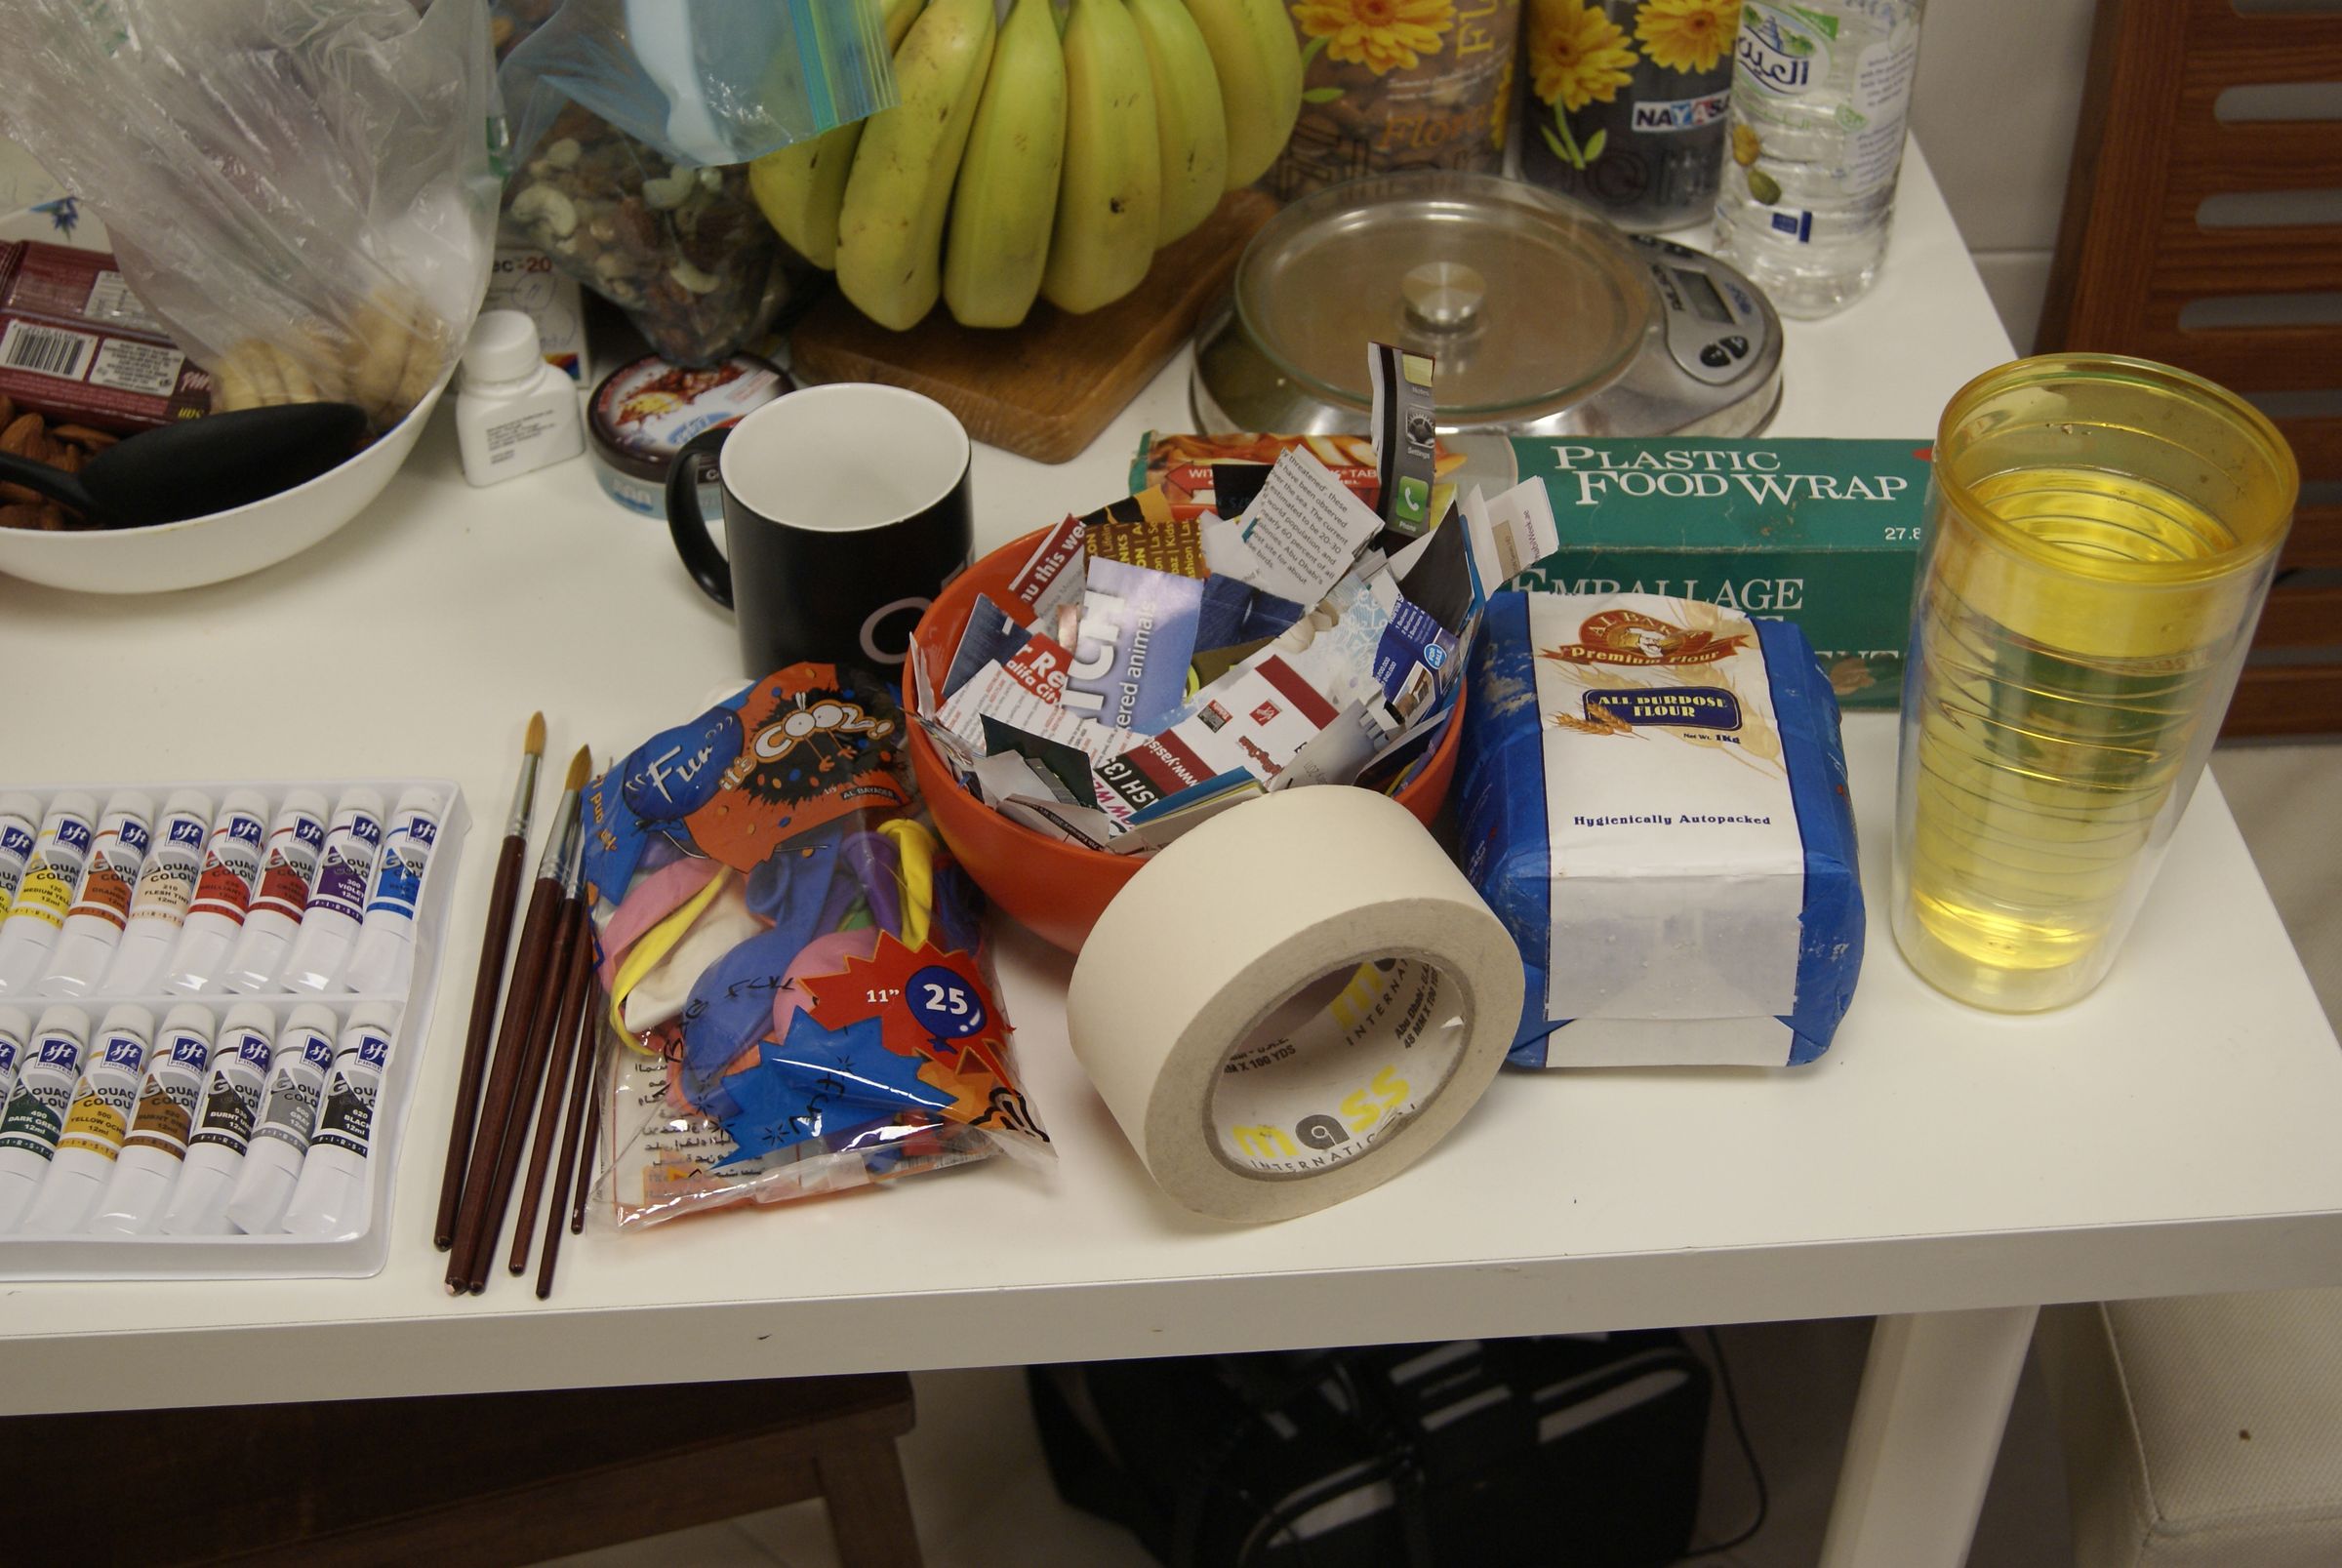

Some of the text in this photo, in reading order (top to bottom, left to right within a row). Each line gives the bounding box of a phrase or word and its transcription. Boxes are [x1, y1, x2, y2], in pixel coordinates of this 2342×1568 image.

[1407, 447, 1431, 460] Settings
[1550, 446, 1781, 471] PLASTIC
[1283, 466, 1347, 527] have been observed
[1572, 470, 1909, 505] FOOD WRAP
[1328, 493, 1347, 511] these
[1269, 486, 1302, 516] estimated
[1311, 523, 1318, 533] be
[1319, 533, 1341, 553] 20-30
[1284, 483, 1296, 496] the
[1296, 494, 1309, 507] sea.
[1310, 507, 1322, 521] The
[1323, 521, 1347, 543] current
[1259, 509, 1280, 530] nearly
[1281, 527, 1291, 538] 60
[1290, 539, 1316, 563] percent
[1317, 561, 1324, 570] of
[1268, 499, 1285, 516] world
[1322, 550, 1335, 564] and
[1034, 552, 1066, 583] this
[1265, 543, 1275, 554] site
[1278, 554, 1287, 564] for
[1287, 564, 1307, 583] about
[1284, 545, 1298, 560] Abu
[1298, 558, 1324, 583] Dhabi's
[1122, 598, 1157, 678] animals
[1059, 589, 1125, 713] TCH
[1426, 646, 1437, 660] FOR
[1430, 648, 1445, 666] SALE
[1571, 645, 1719, 664] Premium Flour
[1029, 648, 1073, 692] Re
[1598, 695, 1728, 708] ALL PURPOSE
[1634, 705, 1696, 717] FLOUR
[1715, 734, 1741, 744] 1Kg
[1117, 774, 1160, 812] SH
[1574, 815, 1771, 827] Hygienically Autopacked
[23, 887, 53, 897] MEDIUM
[144, 890, 173, 899] FLESH
[346, 879, 361, 889] 300
[923, 984, 968, 1015] 25
[1393, 1018, 1411, 1039] Abu
[1403, 1034, 1415, 1049] 48
[1412, 1016, 1427, 1034] MM
[1422, 1006, 1432, 1016] X
[1238, 1044, 1296, 1072] X 100 YDS
[71, 1116, 104, 1126] YELLOW
[97, 1110, 112, 1119] 500
[210, 1111, 239, 1121] BURNT
[290, 1110, 310, 1127] GRAY
[352, 1108, 368, 1120] 620
[1232, 1065, 1410, 1159] mass
[344, 1123, 365, 1135] 12ml
